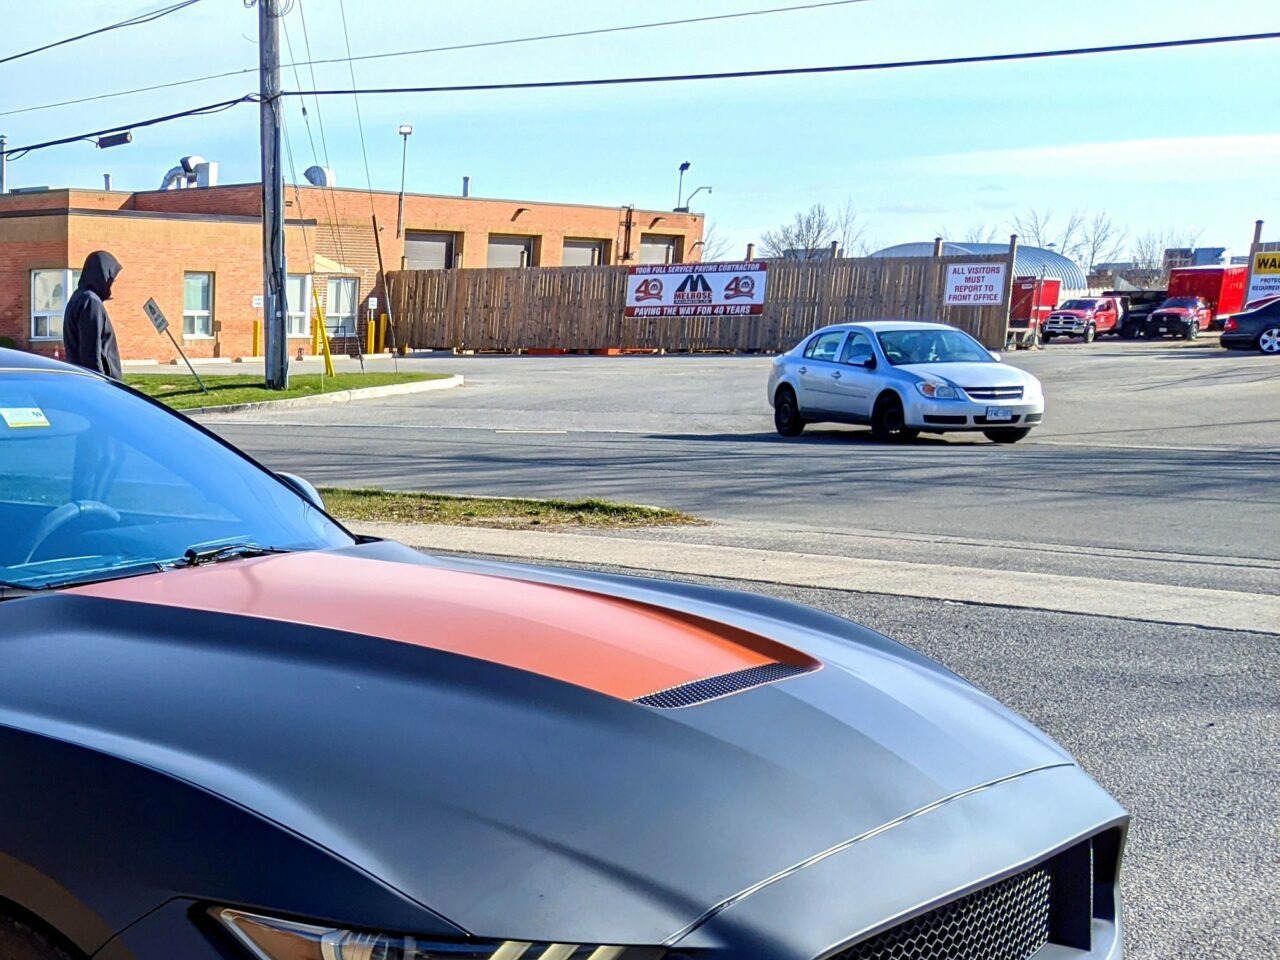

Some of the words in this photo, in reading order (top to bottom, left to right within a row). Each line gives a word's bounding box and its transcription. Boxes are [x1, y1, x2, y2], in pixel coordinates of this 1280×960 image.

[1258, 258, 1280, 269] WA
[635, 267, 651, 275] YOUR
[652, 266, 667, 274] FULL
[668, 265, 693, 273] SERVICE
[694, 264, 718, 273] PAVING
[718, 263, 760, 272] CONTRACTOR
[952, 267, 966, 275] ALL
[967, 266, 1001, 275] VISITORS
[954, 285, 982, 293] REPORT
[984, 284, 994, 292] TO
[674, 291, 713, 300] MELROSE
[973, 293, 999, 301] OFFICE
[634, 307, 661, 316] PAVING
[663, 307, 677, 315] THE
[679, 306, 697, 315] WAY
[698, 306, 712, 315] FOR
[713, 306, 724, 314] 40
[726, 305, 751, 314] YEARS
